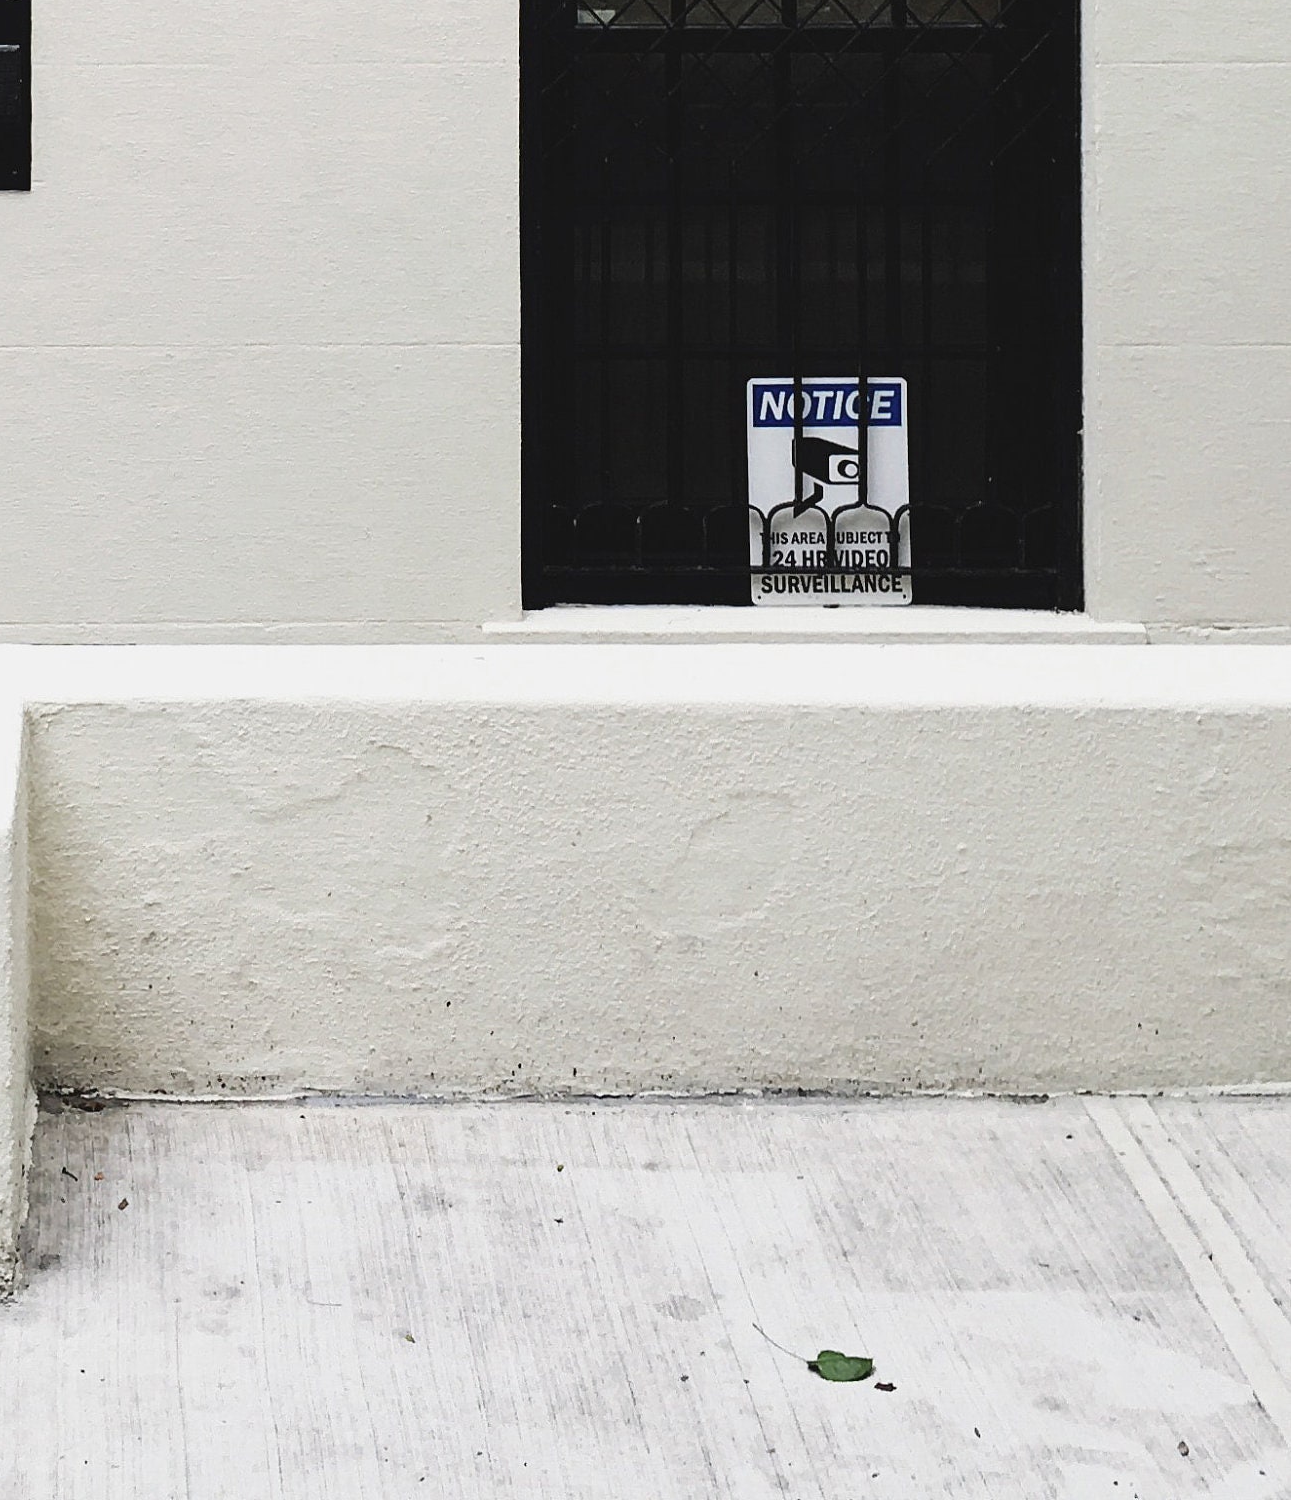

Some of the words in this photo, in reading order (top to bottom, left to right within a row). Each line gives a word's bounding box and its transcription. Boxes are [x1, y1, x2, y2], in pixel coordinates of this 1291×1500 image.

[759, 390, 895, 421] NOTICE
[759, 531, 789, 545] HIS
[791, 531, 826, 545] AREA
[828, 531, 883, 545] UBJECT
[772, 549, 797, 569] 24
[802, 549, 828, 569] HR
[833, 549, 889, 569] VIDEO
[760, 574, 904, 594] SURVEILLANCE
